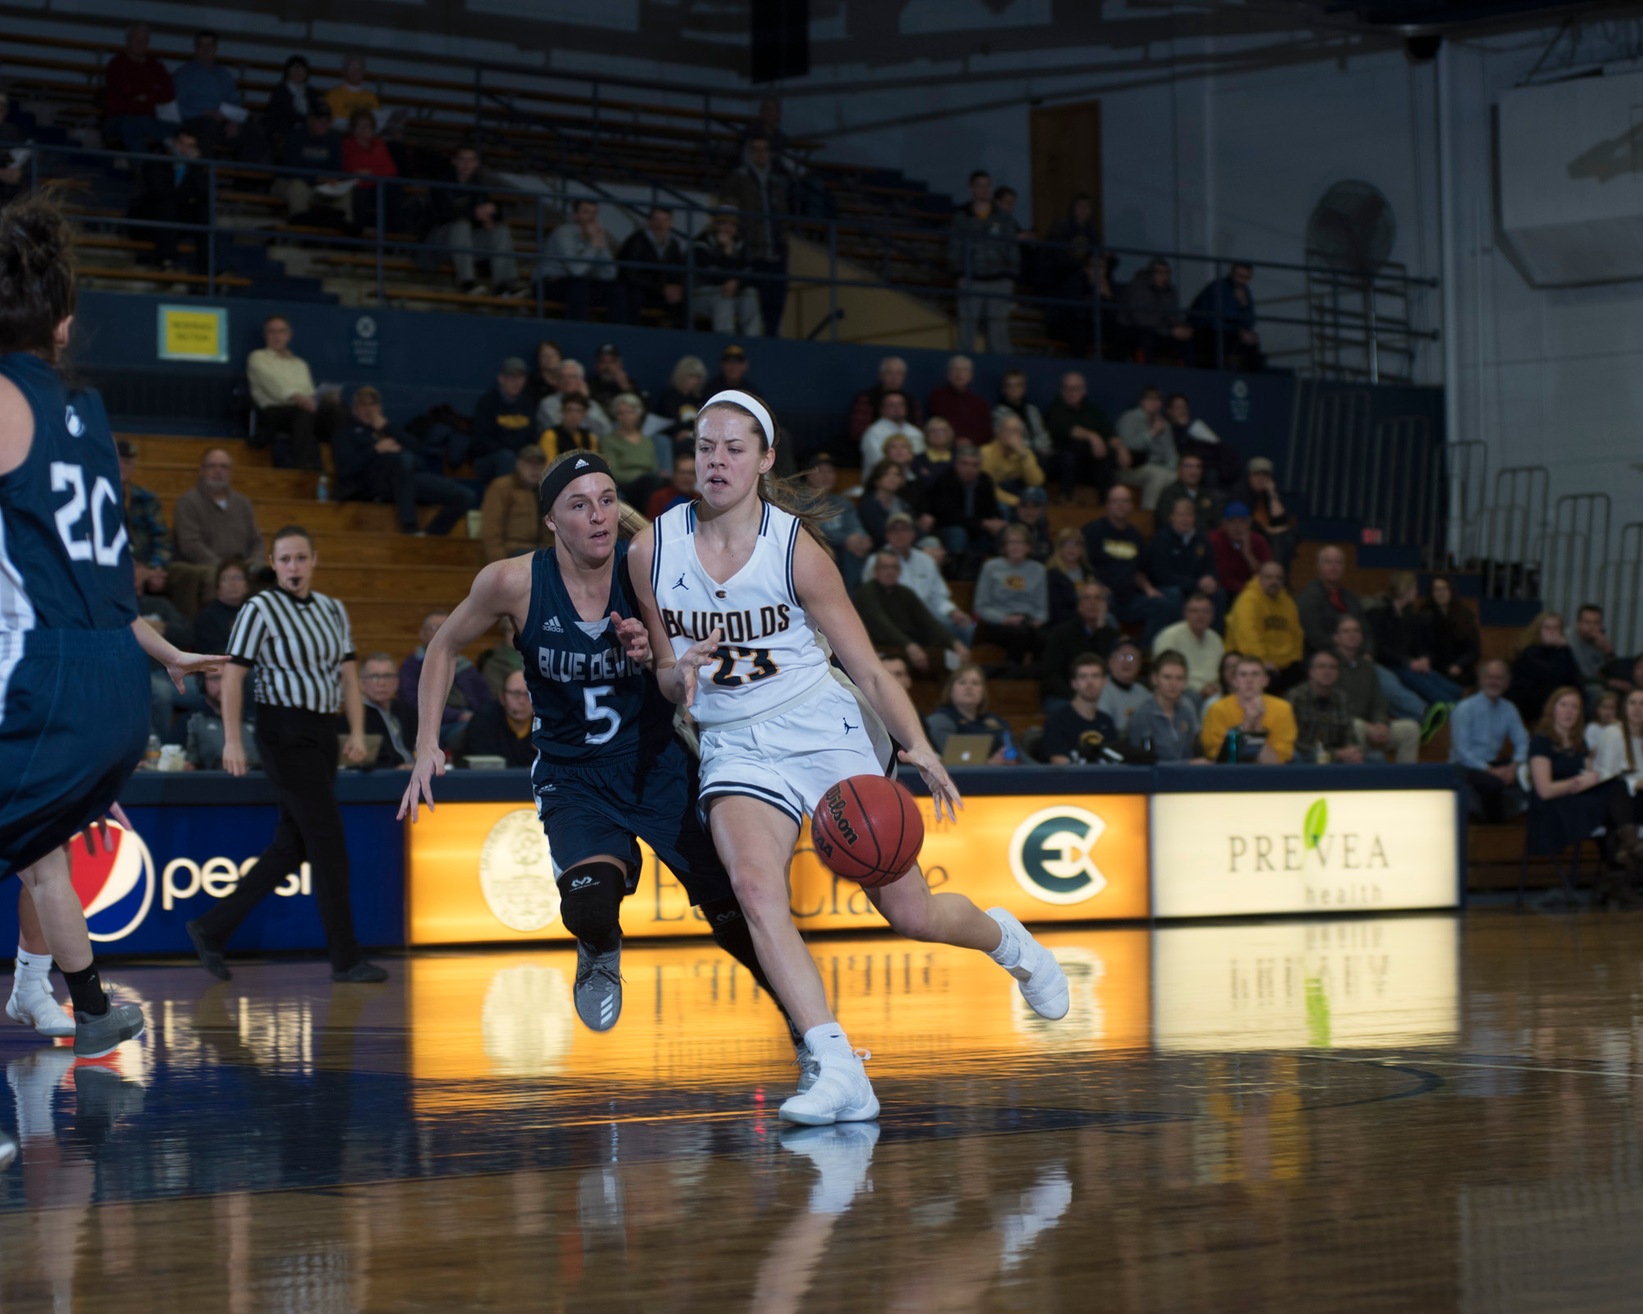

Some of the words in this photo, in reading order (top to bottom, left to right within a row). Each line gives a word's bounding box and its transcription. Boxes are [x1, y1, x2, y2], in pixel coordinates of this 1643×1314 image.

[542, 625, 564, 634] adidas
[661, 603, 790, 643] BLUGOLDS
[538, 646, 586, 683] BLUE
[709, 645, 780, 688] 23
[582, 685, 622, 745] 5
[824, 783, 860, 849] Wilson
[1227, 833, 1390, 873] PREVEA
[1304, 883, 1384, 905] health
